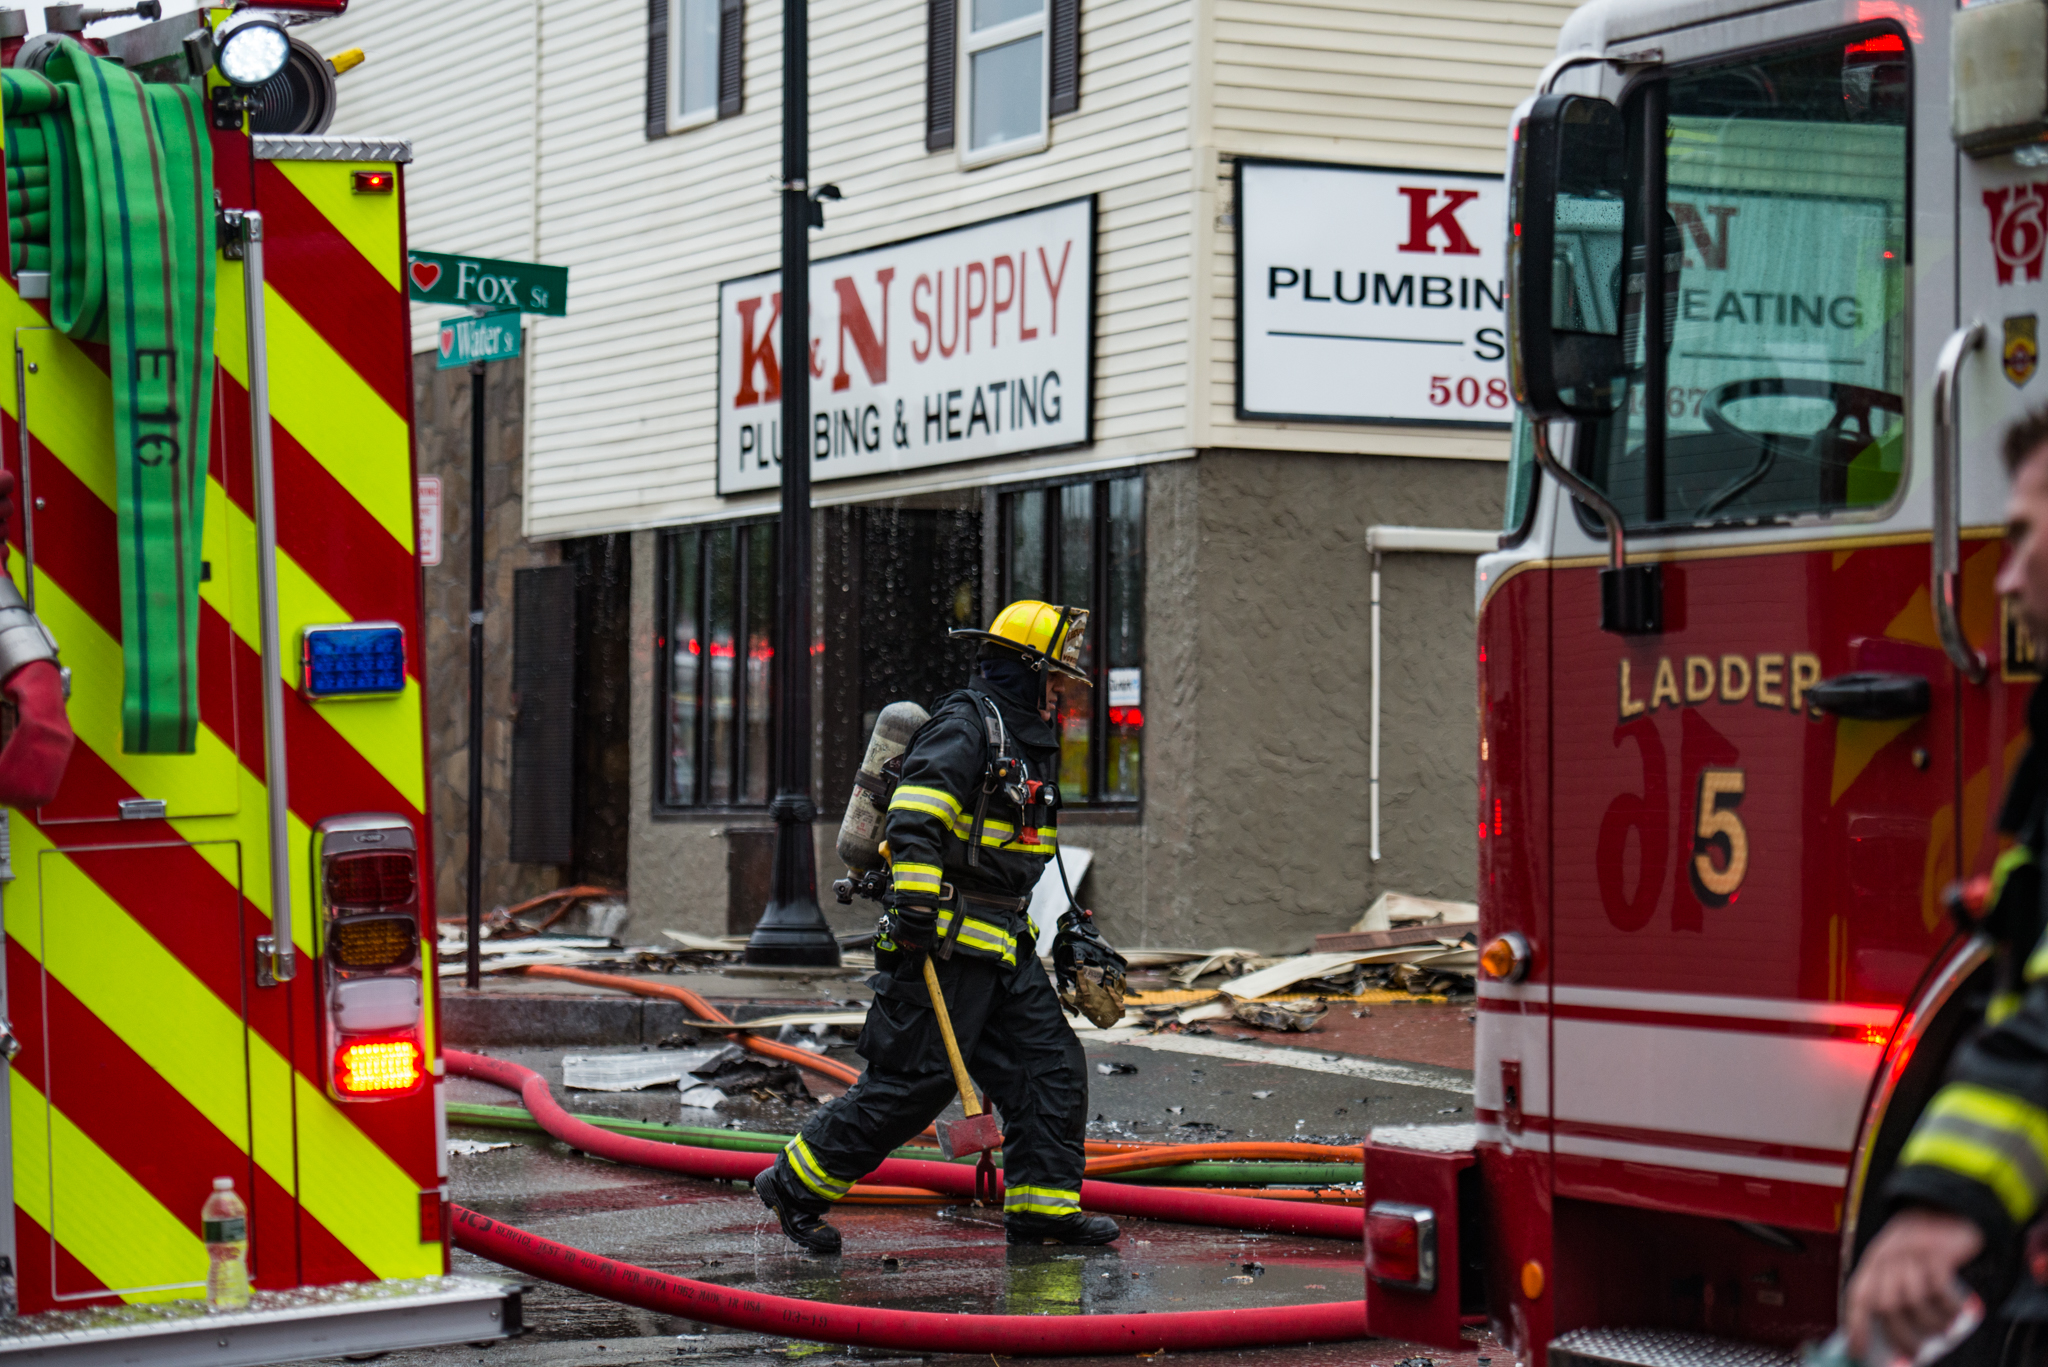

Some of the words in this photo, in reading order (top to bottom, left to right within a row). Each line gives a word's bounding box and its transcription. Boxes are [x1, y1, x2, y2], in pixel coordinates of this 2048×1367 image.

[1397, 186, 1481, 256] K
[1667, 202, 1739, 271] N
[530, 285, 549, 308] St
[734, 291, 782, 408] K
[831, 266, 895, 393] N
[911, 239, 1073, 363] SUPPLY
[1268, 266, 1504, 312] PLUMBIN
[1681, 289, 1865, 330] EATING
[456, 320, 503, 360] Water
[739, 404, 881, 472] PLUBING
[893, 398, 910, 449] &
[923, 370, 1062, 446] HEATING
[1428, 375, 1508, 410] 508
[1629, 385, 1708, 418] 167
[1618, 652, 1823, 721] LADDER
[1692, 767, 1750, 902] 5
[495, 1225, 534, 1248] SERVICE
[538, 1241, 560, 1257] TEST
[564, 1250, 577, 1263] TO
[580, 1257, 598, 1270] 400
[600, 1262, 618, 1277] PSI
[621, 1269, 640, 1284] PER
[644, 1275, 667, 1291] NFPA
[672, 1283, 695, 1299] 1962
[699, 1290, 722, 1306] MADE
[728, 1296, 740, 1309] IN
[743, 1299, 761, 1312] USA
